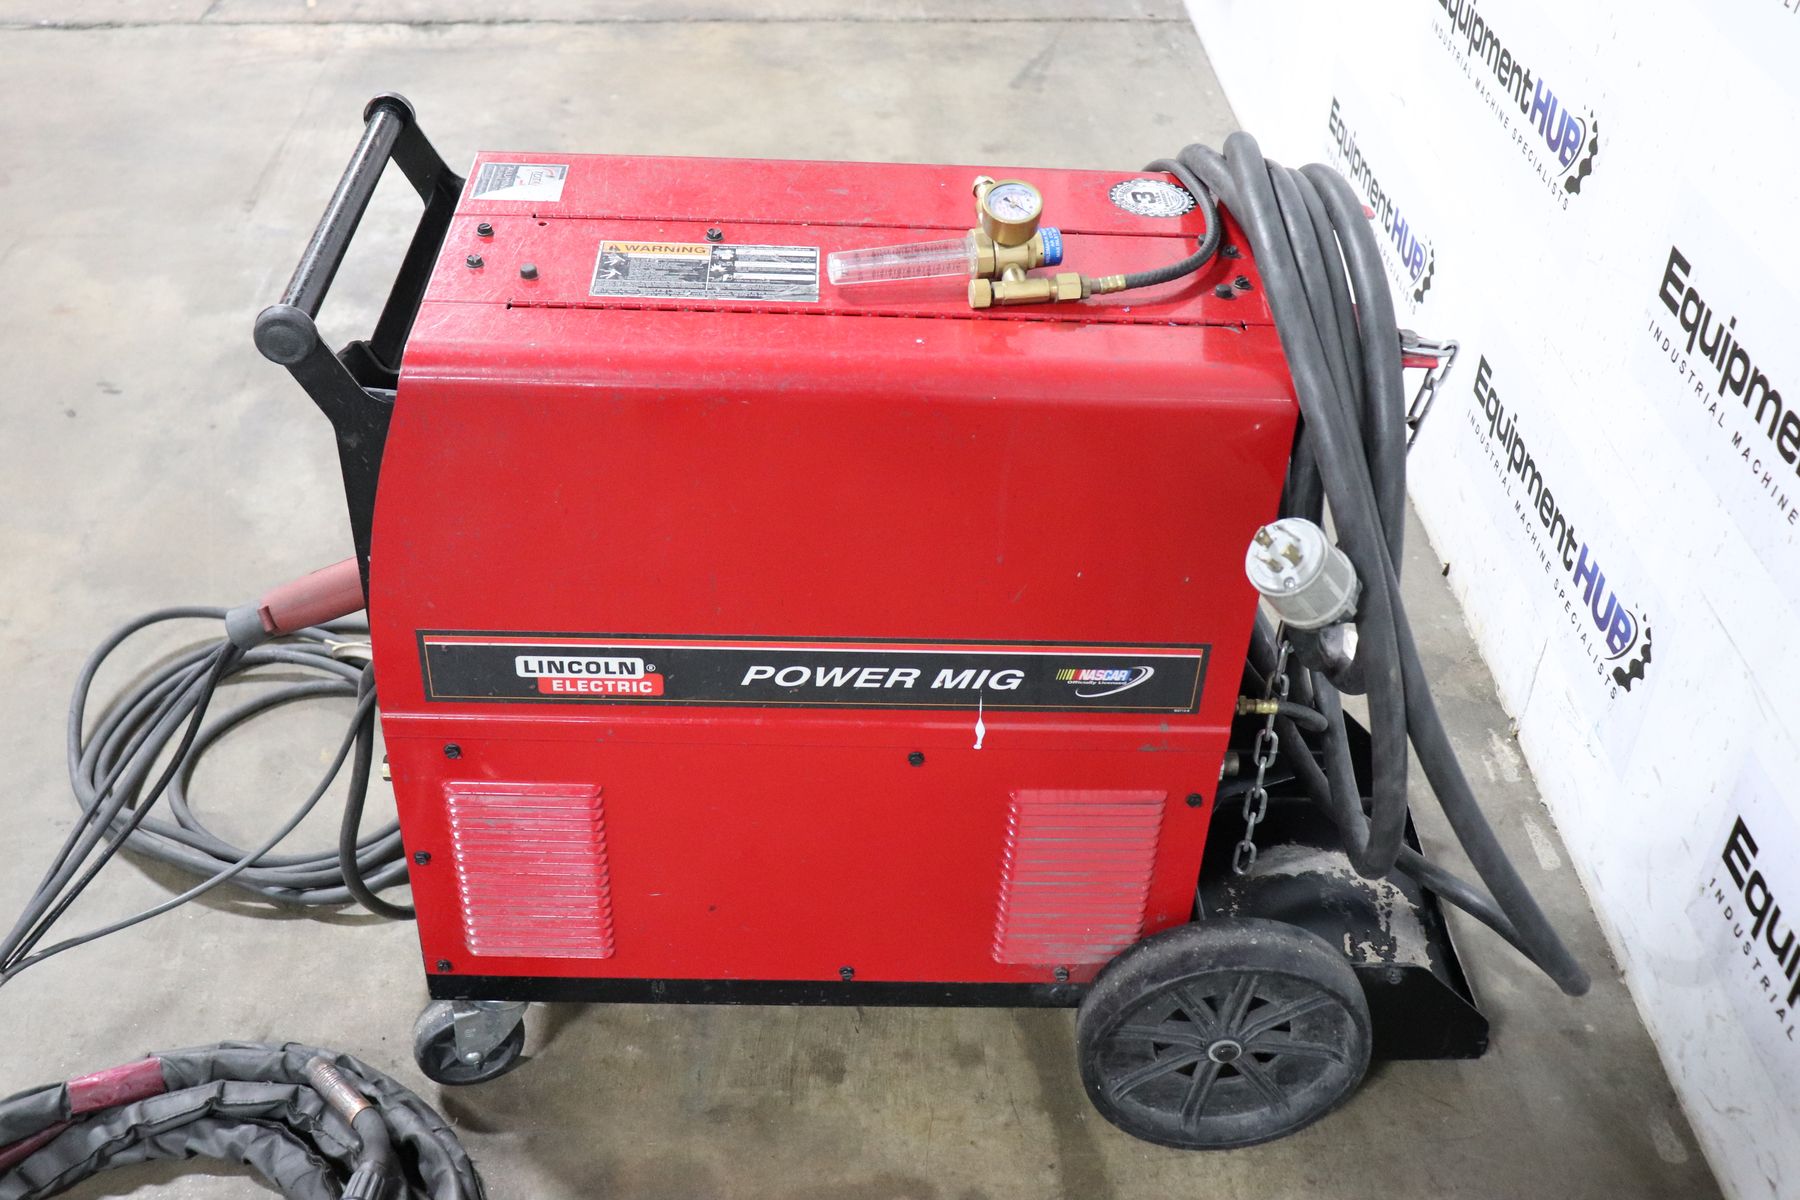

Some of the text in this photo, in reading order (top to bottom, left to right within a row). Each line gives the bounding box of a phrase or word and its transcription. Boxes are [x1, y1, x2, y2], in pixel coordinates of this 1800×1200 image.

[1329, 96, 1423, 281] EquipmentHUB
[1432, 18, 1569, 211] INDUSTRIAL MACHINE SPECIALISTS
[625, 244, 706, 254] WARNING
[1131, 191, 1156, 204] 3
[1648, 319, 1799, 525] INDUSTRIAL MACHINE
[1658, 245, 1800, 478] Equipme
[1467, 409, 1617, 700] INDUSTRIAL MACHINE SPECIALISTS
[1473, 353, 1632, 655] EquipmentHUB
[523, 659, 637, 676] LINCOLN
[551, 679, 653, 694] ELECTRIC
[740, 665, 1025, 691] POWER MIG
[1079, 669, 1129, 681] NASCAR
[1709, 877, 1795, 1042] INDUSTRIAL
